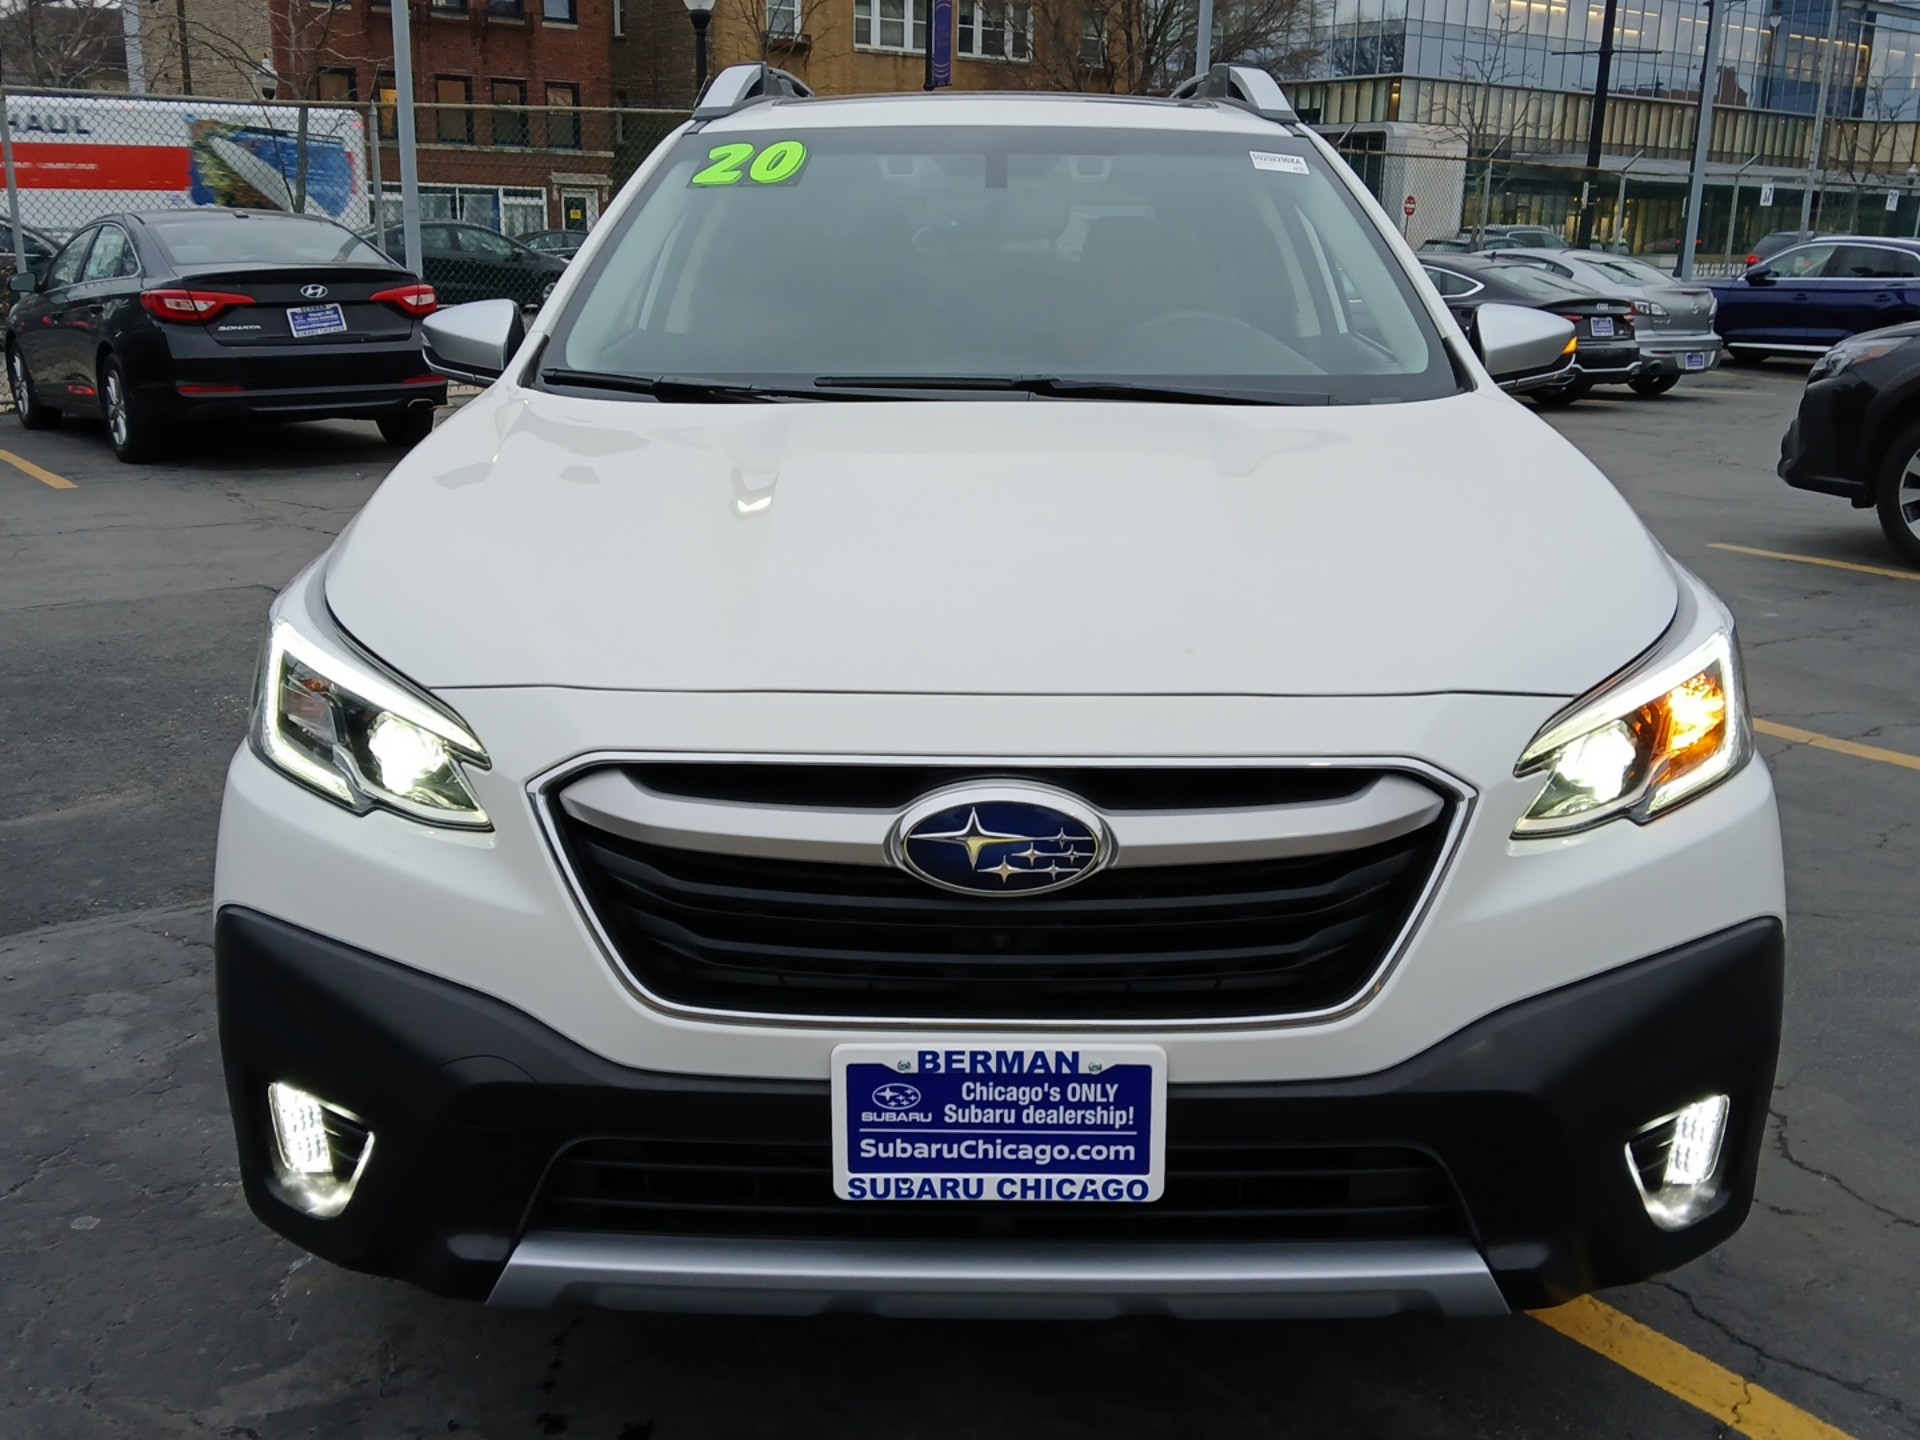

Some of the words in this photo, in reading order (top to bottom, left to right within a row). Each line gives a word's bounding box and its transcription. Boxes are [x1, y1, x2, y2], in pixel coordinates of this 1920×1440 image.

[691, 140, 808, 185] 20
[917, 1050, 1080, 1074] BERMAN
[961, 1081, 1061, 1106] Chicago's
[1066, 1082, 1119, 1103] ONLY
[861, 1112, 933, 1122] SUBARU
[943, 1103, 1016, 1125] Subaru
[1021, 1105, 1135, 1129] dealership!
[858, 1138, 1136, 1165] SubaruChicago.com
[847, 1177, 984, 1200] SUBARU
[996, 1178, 1150, 1201] CHICAGO
